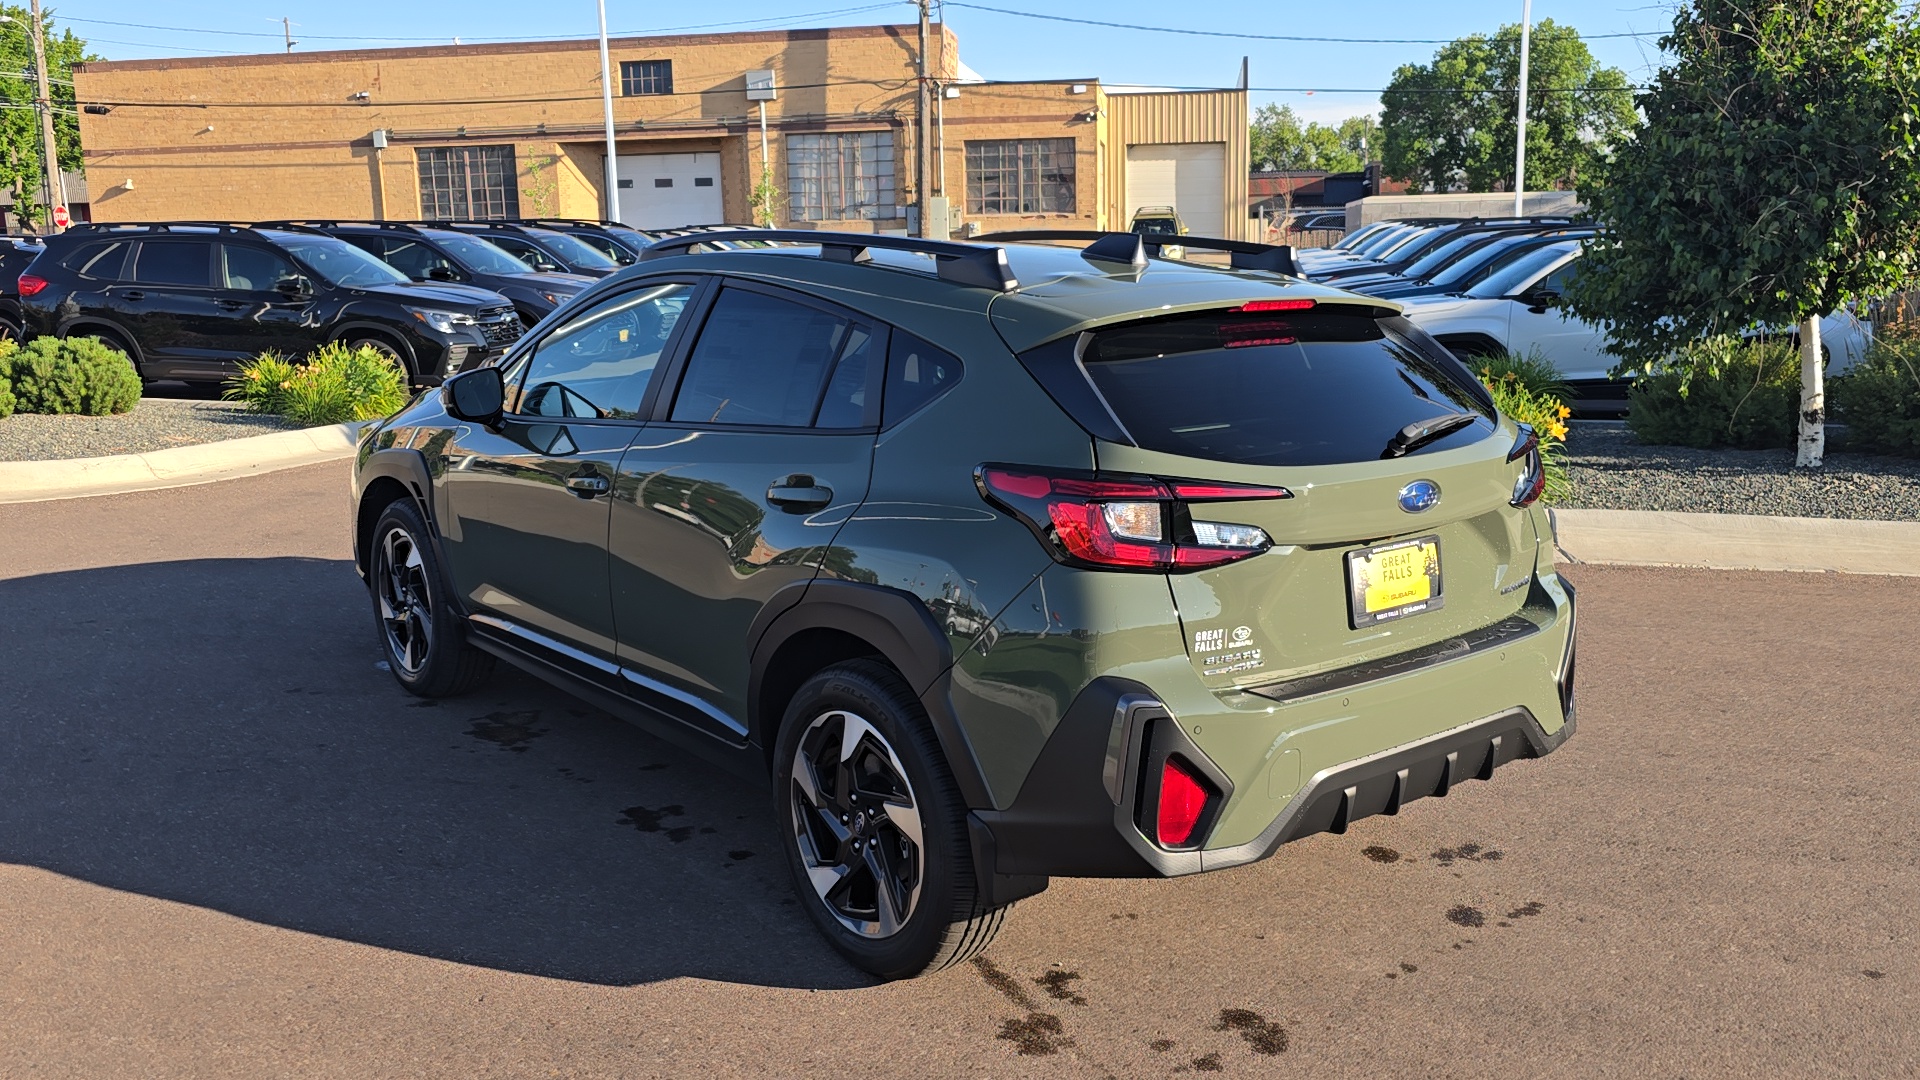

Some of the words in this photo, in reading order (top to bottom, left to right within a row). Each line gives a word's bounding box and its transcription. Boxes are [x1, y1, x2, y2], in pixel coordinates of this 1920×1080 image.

[54, 211, 69, 221] STOP
[1381, 552, 1411, 569] GREAT
[1382, 565, 1413, 583] FALLS
[1390, 590, 1417, 601] SUBARU
[1195, 628, 1224, 642] GREAT
[1194, 639, 1223, 653] FALLS
[1203, 648, 1261, 666] SUBARU
